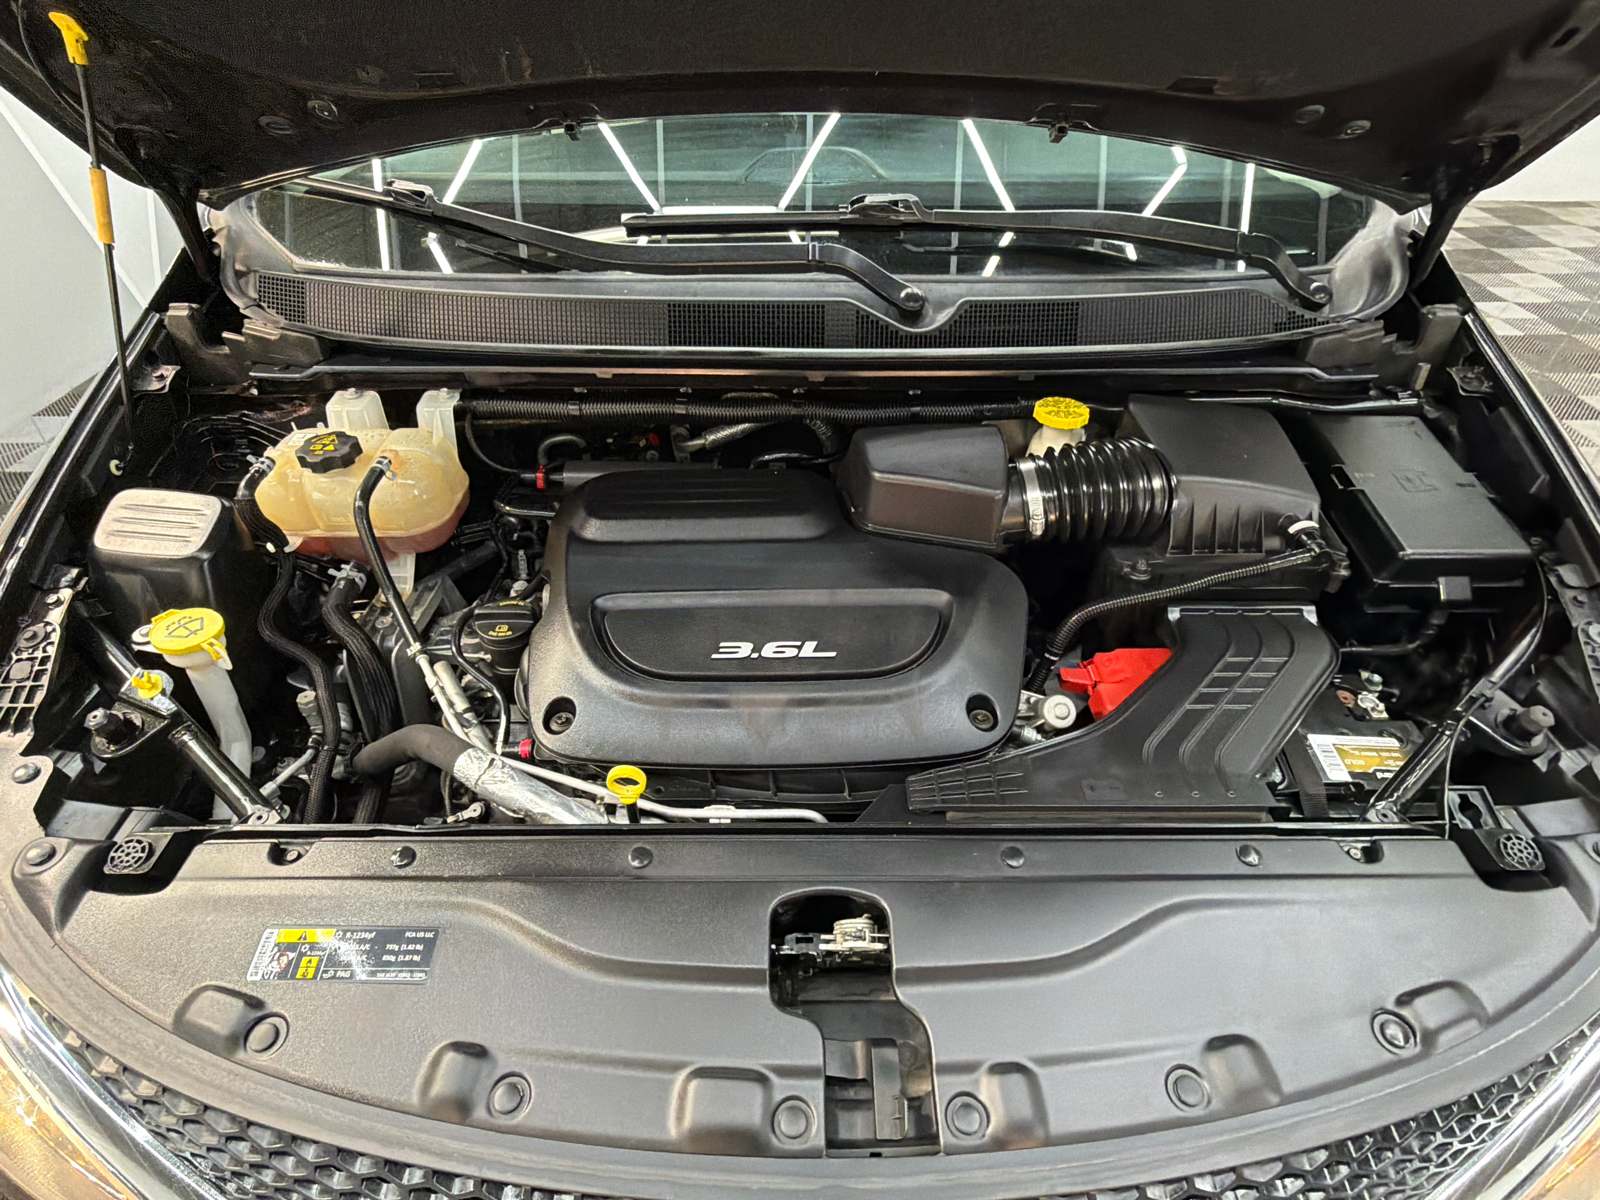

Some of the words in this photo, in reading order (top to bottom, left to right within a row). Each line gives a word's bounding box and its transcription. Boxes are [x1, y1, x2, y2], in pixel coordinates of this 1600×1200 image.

[711, 641, 837, 659] 3.6L
[345, 931, 376, 940] R-1234yf
[382, 954, 396, 962] 850g
[336, 970, 350, 978] PAG
